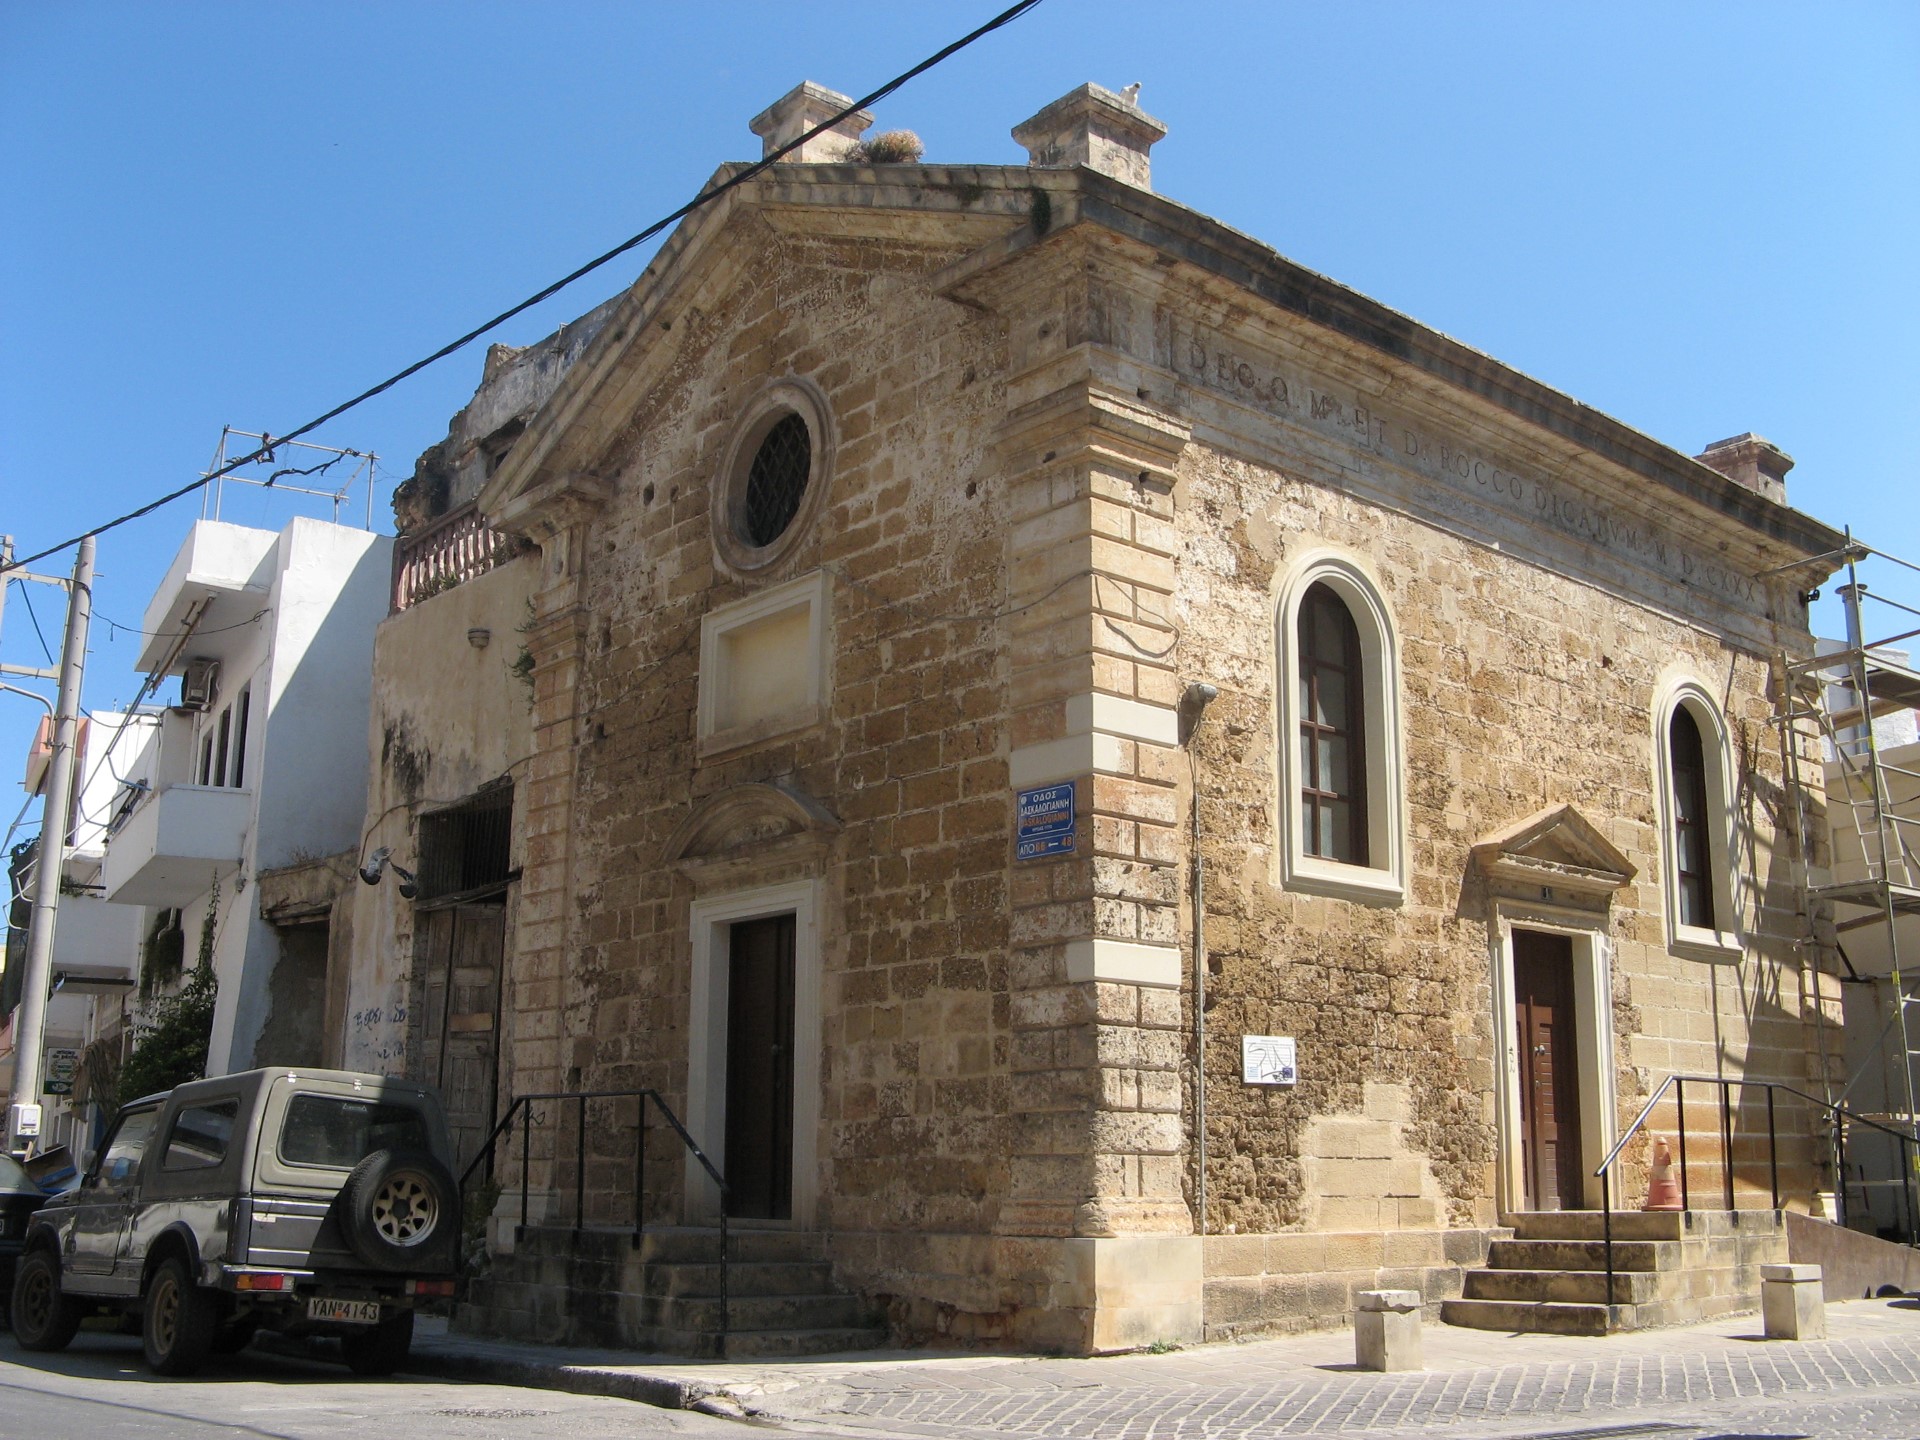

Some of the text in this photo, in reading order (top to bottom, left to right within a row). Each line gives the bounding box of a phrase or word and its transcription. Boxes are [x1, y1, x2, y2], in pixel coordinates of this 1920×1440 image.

[1440, 446, 1523, 500] ROCCO
[1032, 791, 1057, 802] ΟΔΟΣ
[1020, 799, 1070, 816] ΔΑΣΚΑΛΟΓΙΑΝΝΗ
[1020, 843, 1035, 855] ΑΠΟ
